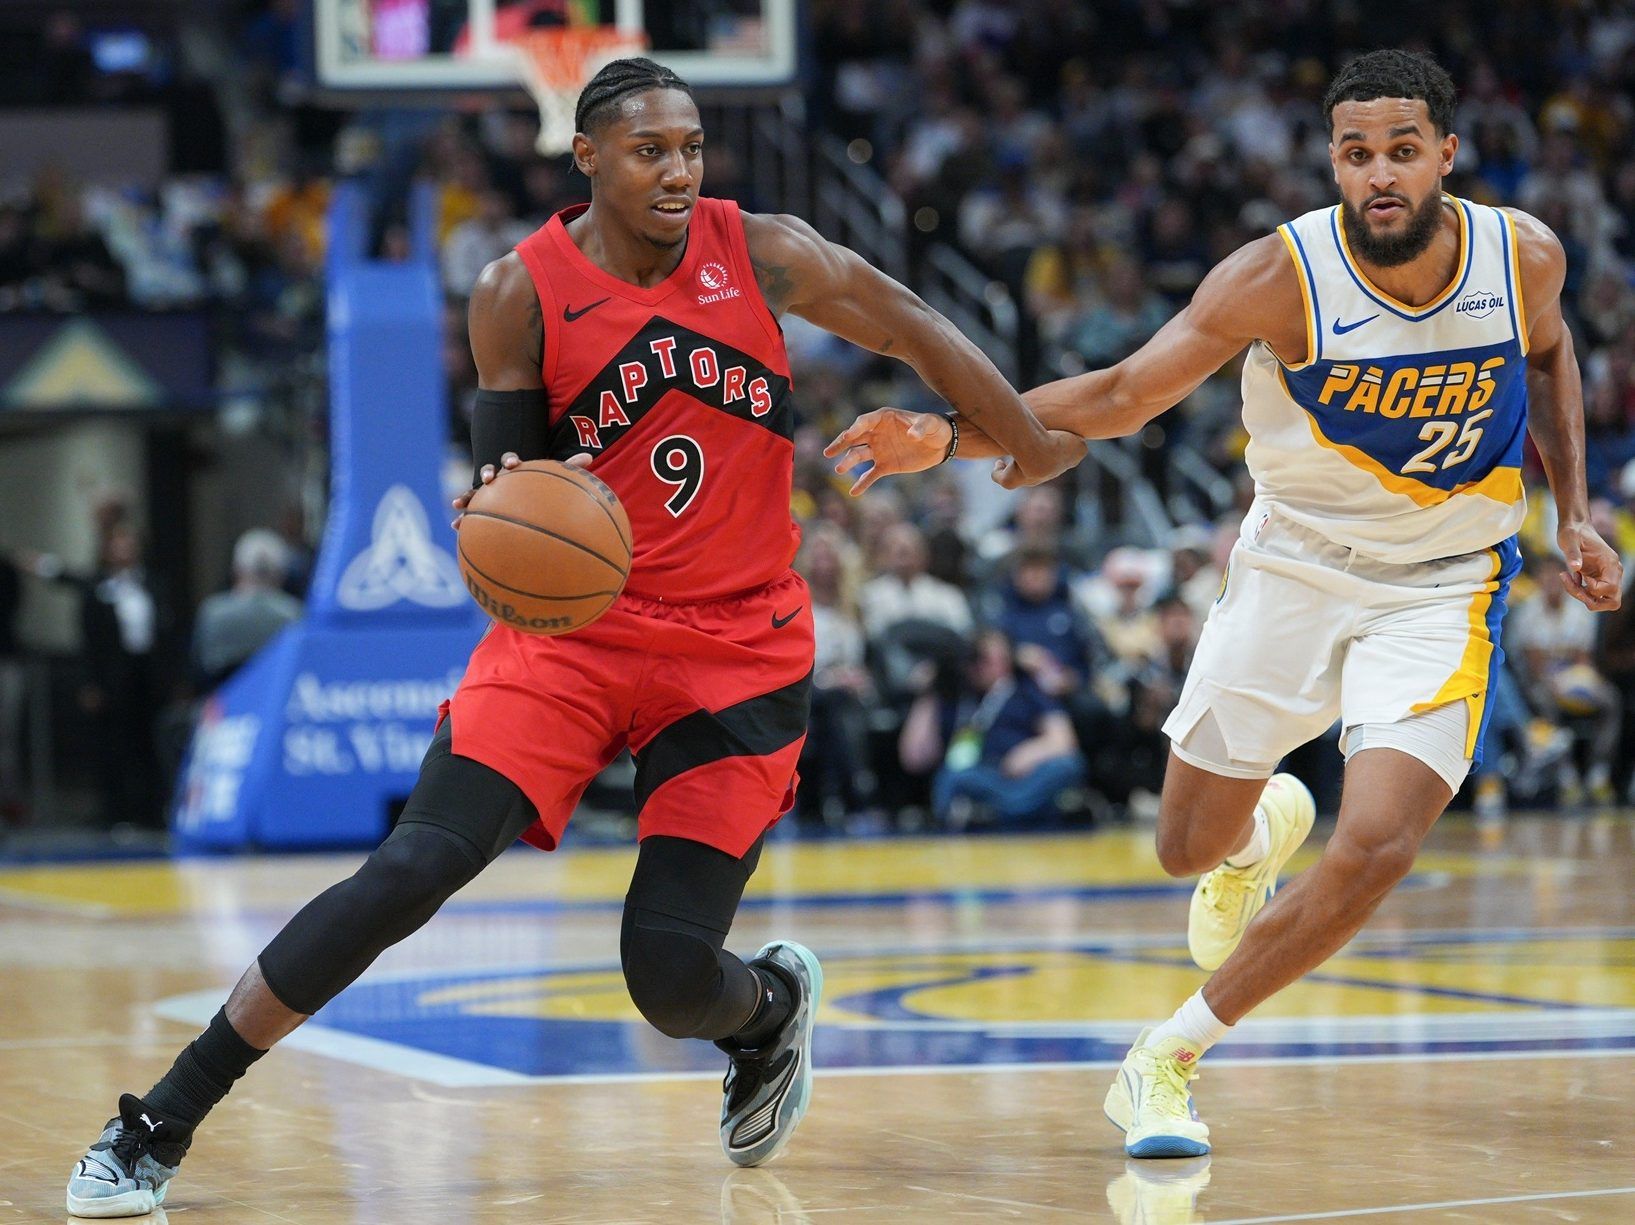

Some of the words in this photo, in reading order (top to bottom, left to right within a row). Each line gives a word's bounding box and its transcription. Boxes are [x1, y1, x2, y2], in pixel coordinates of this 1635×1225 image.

[698, 294, 719, 305] Sun
[719, 286, 740, 300] Life
[1456, 299, 1487, 312] LUCAS
[1489, 297, 1504, 308] OIL
[569, 336, 772, 449] RAPTORS
[1317, 356, 1505, 419] PACERS
[1400, 409, 1494, 475] 25
[650, 434, 705, 518] 9
[464, 570, 573, 629] Wilson
